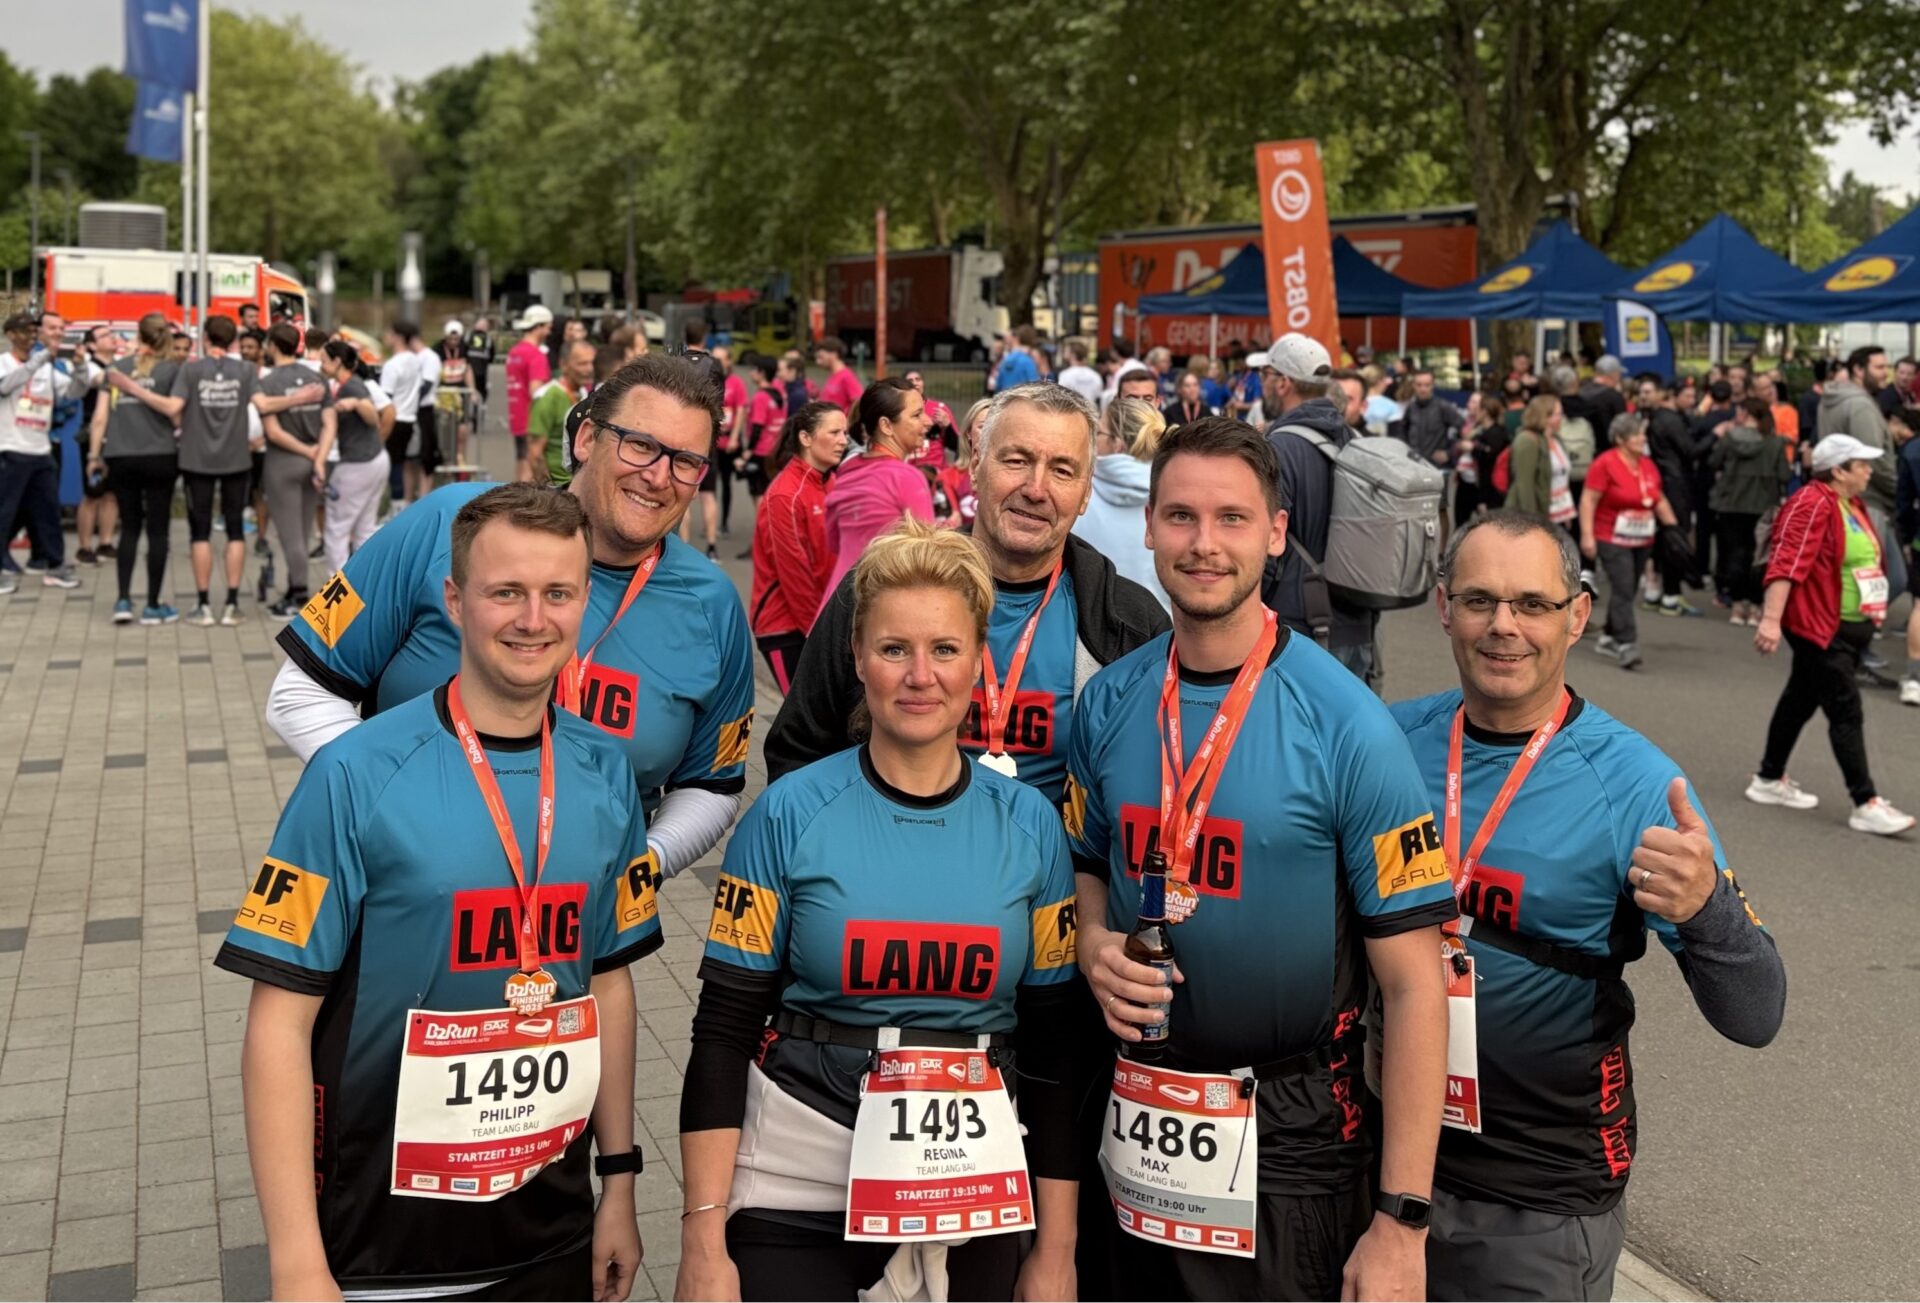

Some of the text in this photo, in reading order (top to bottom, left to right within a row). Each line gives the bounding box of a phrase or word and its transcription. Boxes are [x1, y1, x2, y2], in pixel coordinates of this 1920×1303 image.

[252, 863, 299, 906] IF
[714, 878, 754, 921] EIF
[239, 906, 297, 936] PPE
[714, 923, 761, 948] PPE
[848, 938, 995, 995] LANG
[506, 980, 556, 998] B2Run
[511, 995, 552, 1006] FINISHER
[519, 1003, 543, 1013] 2025
[425, 1022, 478, 1040] B2Run
[880, 1059, 916, 1077] B2Run
[446, 1051, 568, 1105] 1490
[1450, 1080, 1463, 1097] N
[480, 1105, 535, 1123] PHILIPP
[889, 1098, 987, 1142] 1493
[472, 1121, 540, 1137] TEAM LANG BAU
[563, 1126, 575, 1144] N
[1112, 1100, 1218, 1162] 1486
[448, 1140, 552, 1162] STARTZEIT 19:15 Uhr
[924, 1148, 967, 1161] REGINA
[916, 1163, 976, 1175] TEAM LANG BAU
[1141, 1156, 1170, 1174] MAX
[1006, 1177, 1018, 1195] N
[1127, 1166, 1187, 1190] TEAM LANG BAU
[895, 1184, 993, 1200] STARTZEIT 19:15 Uhr
[1115, 1181, 1155, 1205] STARTZEIT
[1157, 1197, 1185, 1211] 19:00
[1188, 1203, 1207, 1214] Uhr
